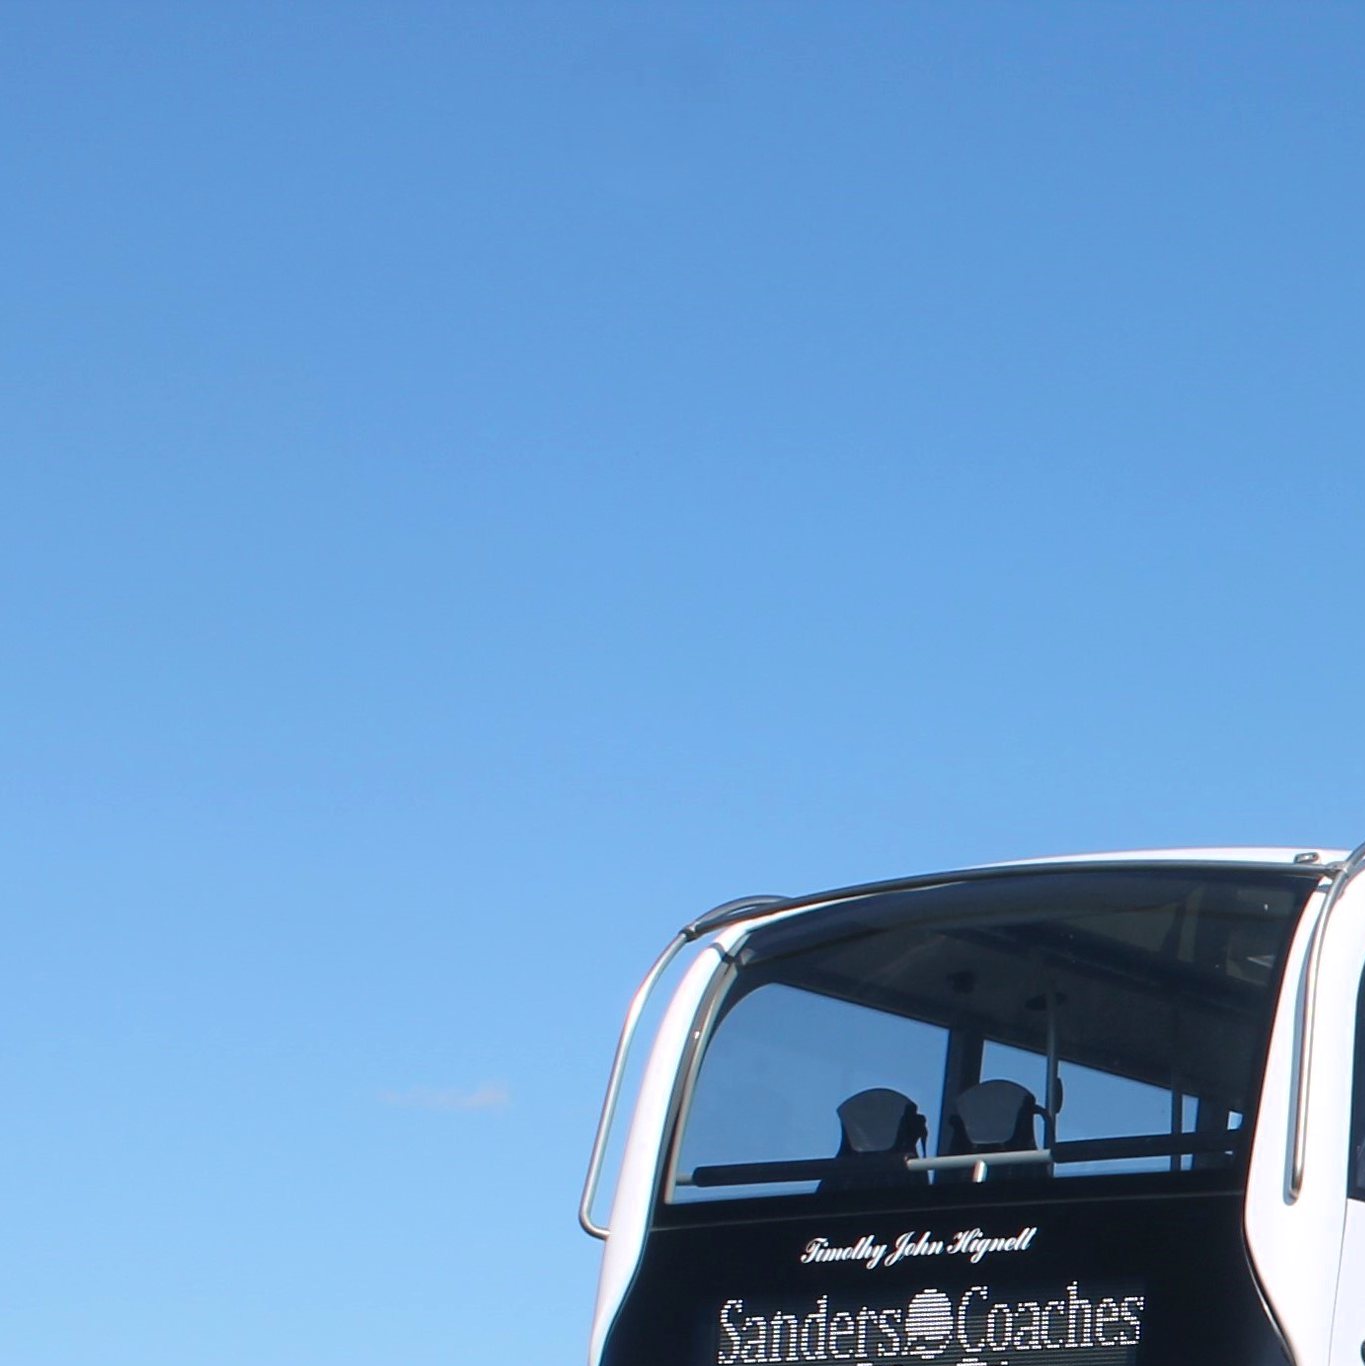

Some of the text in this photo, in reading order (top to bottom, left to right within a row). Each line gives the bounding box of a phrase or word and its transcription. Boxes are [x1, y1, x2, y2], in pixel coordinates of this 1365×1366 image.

[800, 1226, 1038, 1270] Timothy John Hignell
[718, 1281, 1144, 1364] Sanders Coaches
